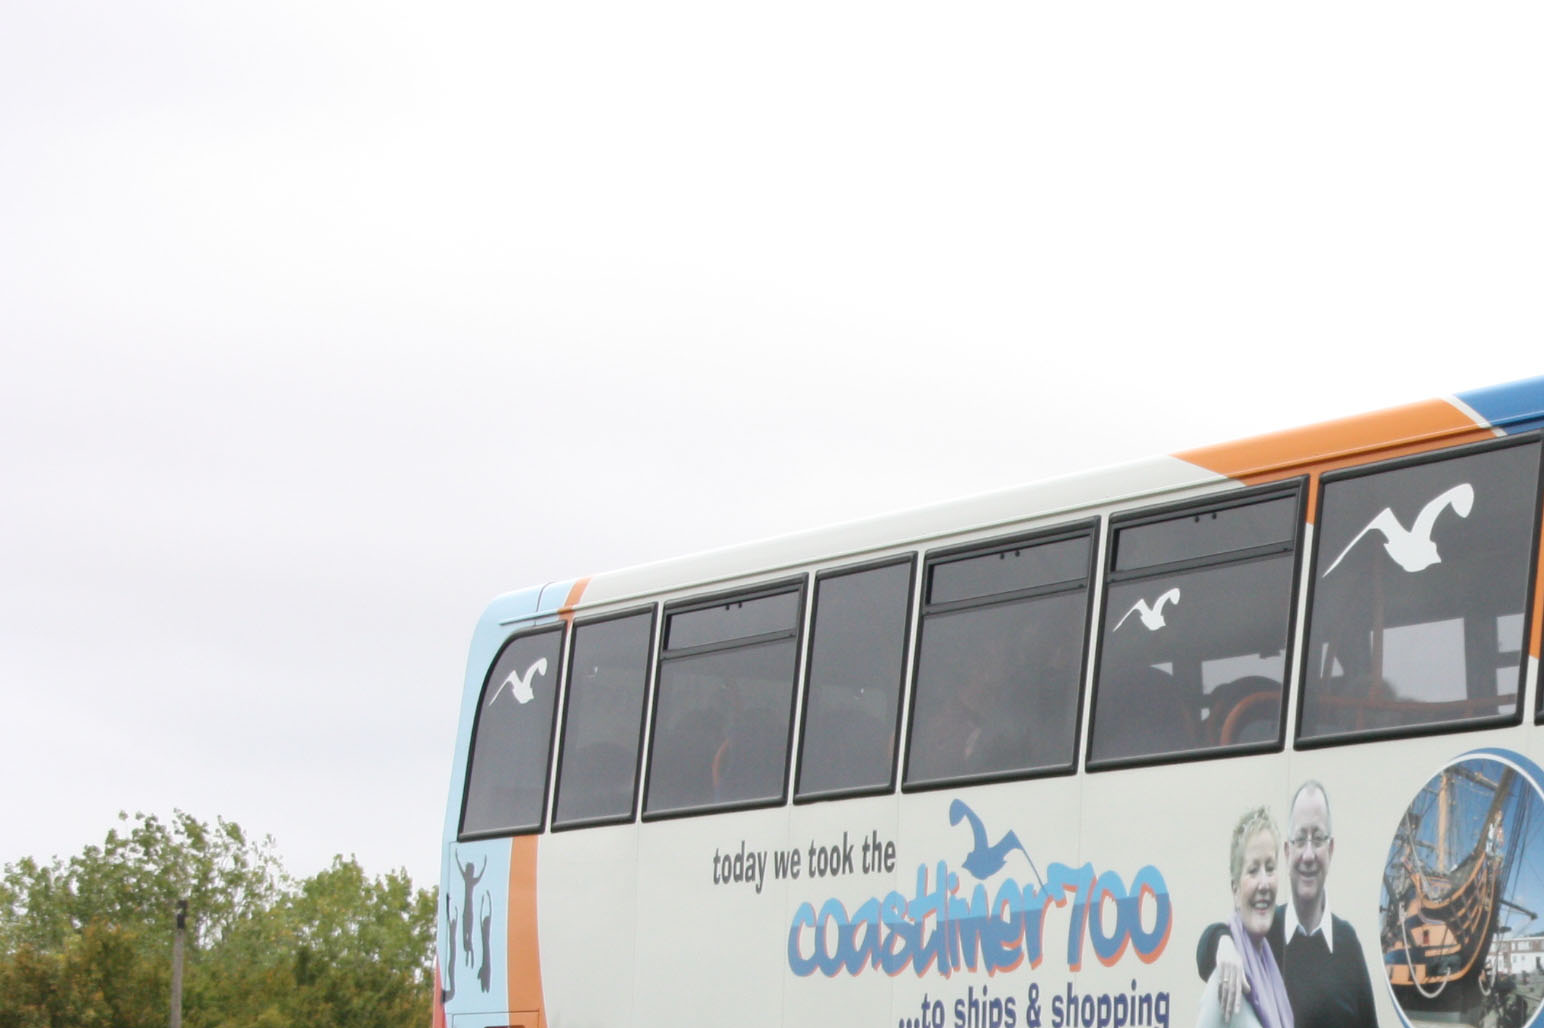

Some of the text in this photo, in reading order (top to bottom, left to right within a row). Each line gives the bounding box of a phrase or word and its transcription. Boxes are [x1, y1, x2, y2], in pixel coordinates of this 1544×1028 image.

[712, 830, 897, 894] today we took the
